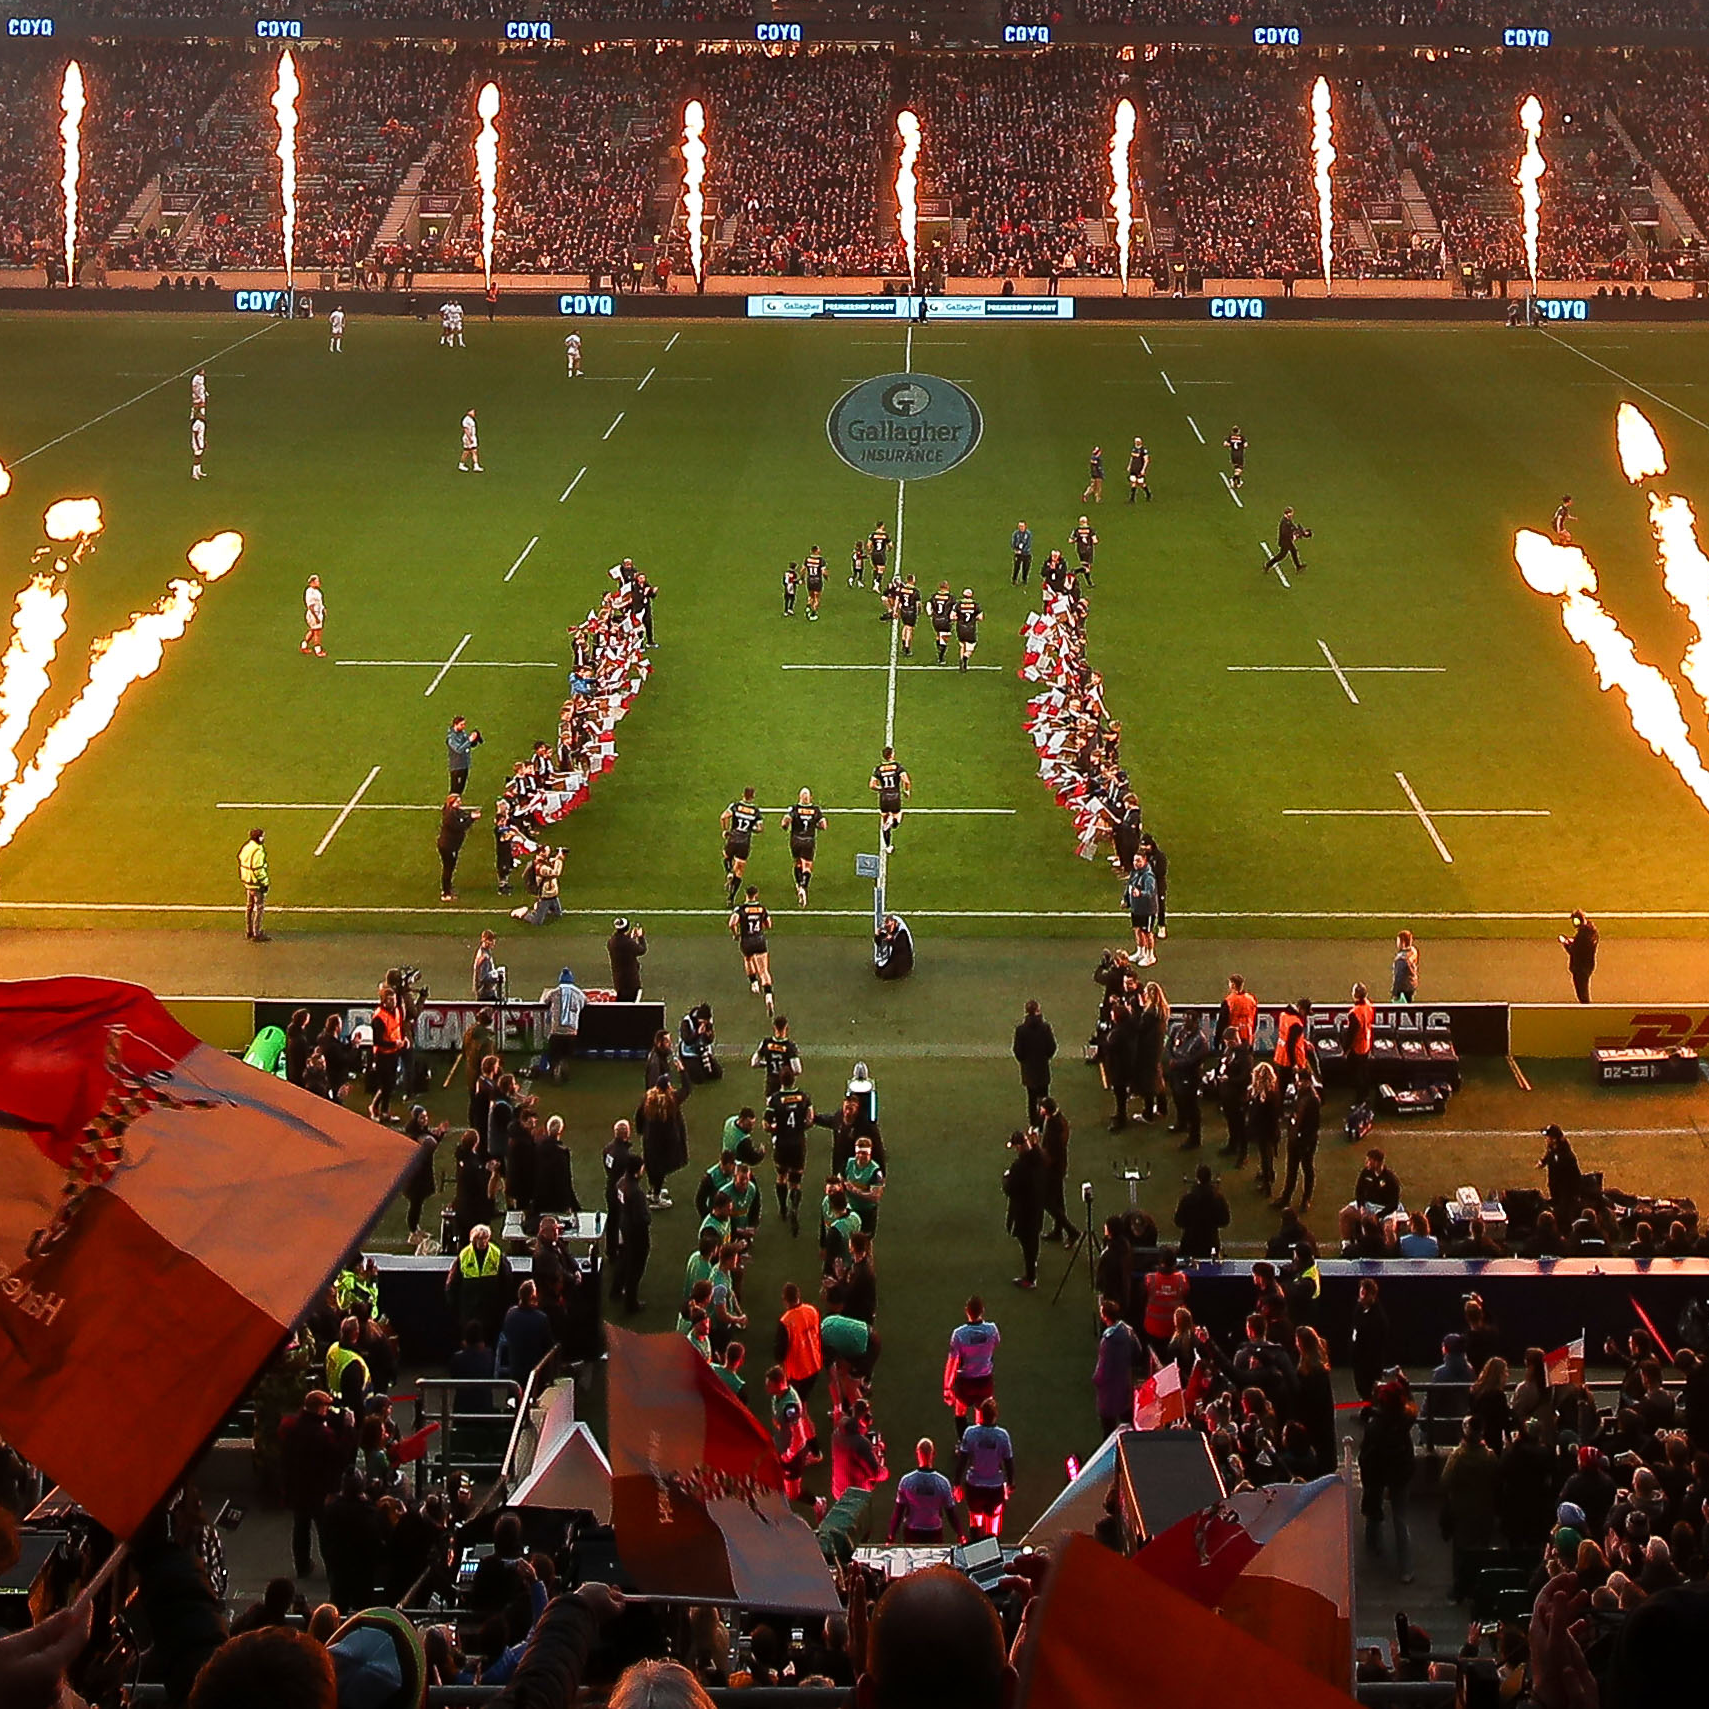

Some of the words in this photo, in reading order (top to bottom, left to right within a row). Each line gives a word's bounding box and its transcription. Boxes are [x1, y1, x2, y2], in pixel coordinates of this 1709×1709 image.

[9, 19, 52, 35] COYQ
[258, 21, 300, 37] COYQ
[507, 23, 550, 40] COYQ
[758, 25, 800, 41] COYQ
[1005, 26, 1048, 43] COYQ
[1255, 28, 1299, 44] COYQ
[1504, 29, 1549, 46] COYQ
[237, 291, 289, 310] COY
[561, 296, 611, 315] COYQ
[1212, 299, 1262, 318] COYQ
[848, 419, 963, 446] Gallagher
[860, 449, 944, 463] INSURANCE
[883, 776, 895, 788] 11
[737, 819, 750, 832] 12
[748, 920, 760, 933] 14
[786, 1111, 796, 1128] 4
